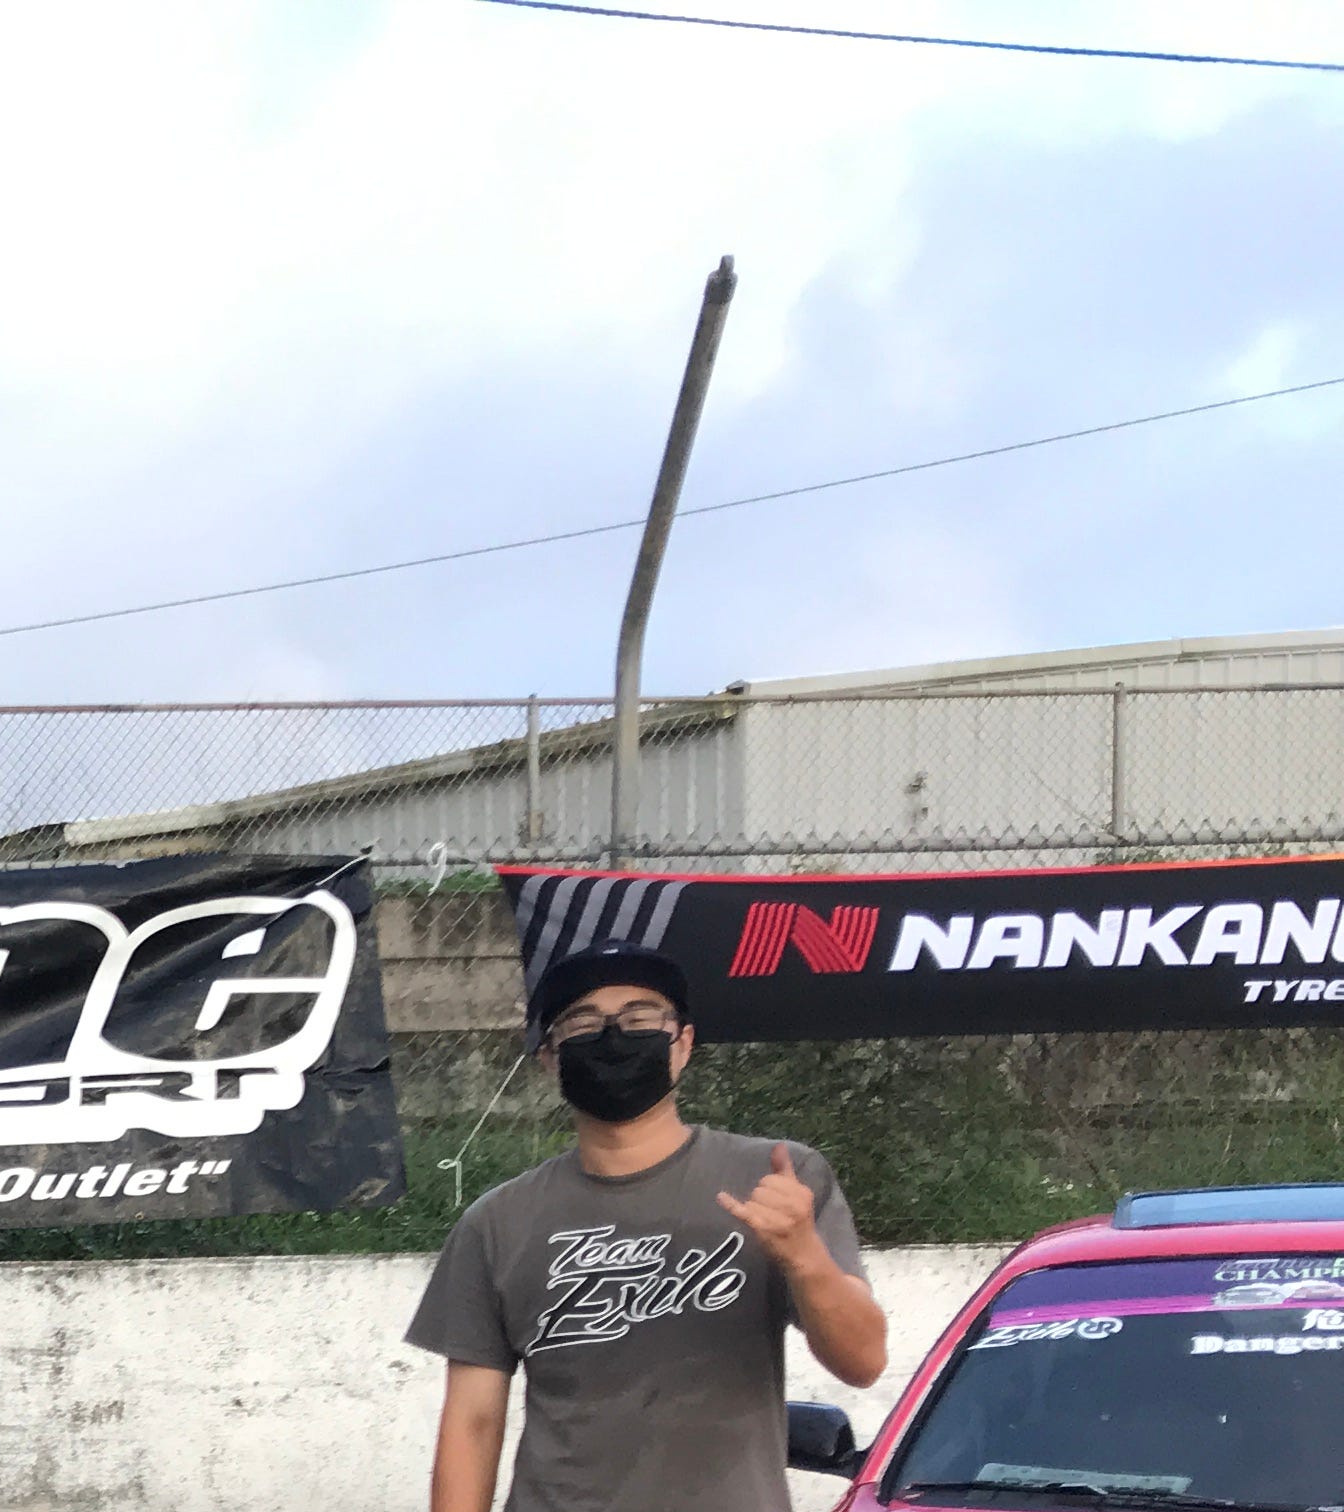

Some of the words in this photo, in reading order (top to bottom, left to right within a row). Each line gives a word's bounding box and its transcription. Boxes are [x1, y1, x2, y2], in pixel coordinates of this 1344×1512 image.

[887, 899, 1344, 972] NANKAN
[548, 1224, 672, 1276] Team
[1214, 1267, 1344, 1281] CHAMPI
[525, 1231, 747, 1357] Exile
[967, 1318, 1080, 1350] Exile
